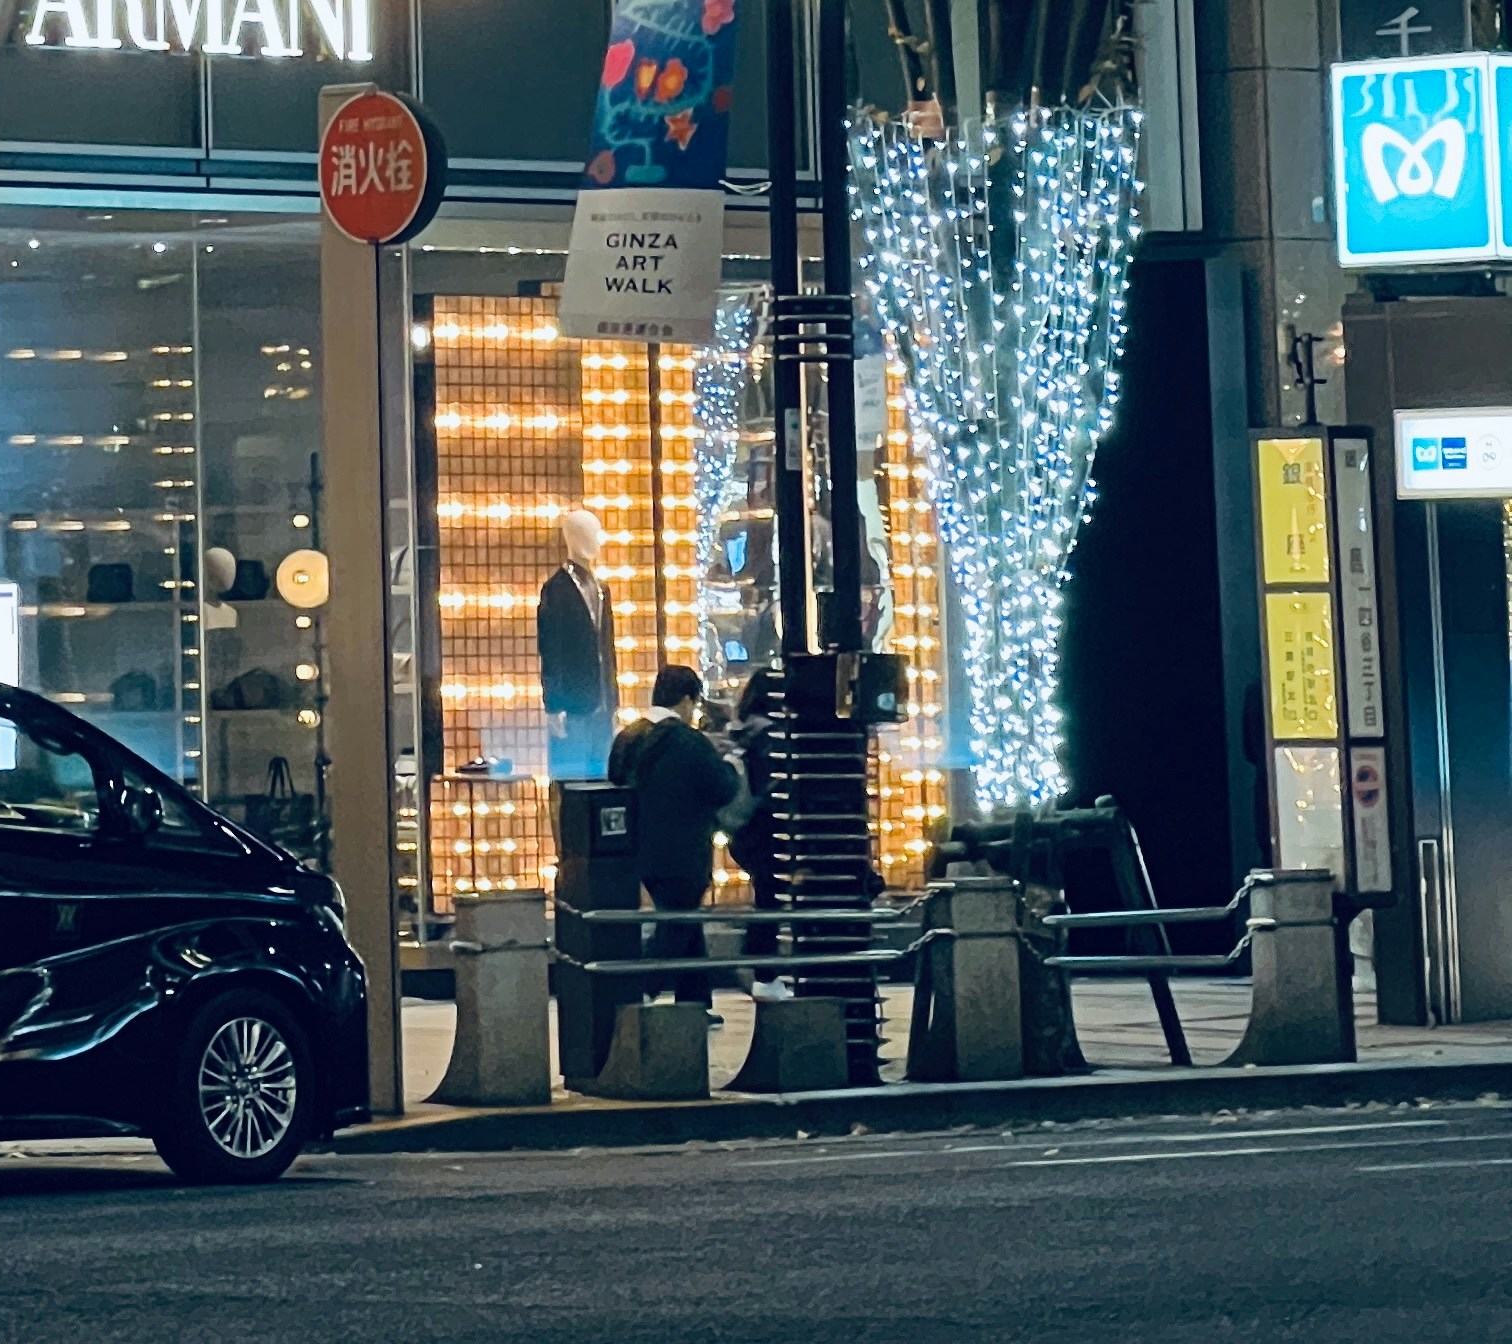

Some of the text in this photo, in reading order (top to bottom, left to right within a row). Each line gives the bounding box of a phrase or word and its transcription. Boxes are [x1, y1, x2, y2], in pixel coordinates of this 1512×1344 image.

[331, 140, 415, 197] 消火栓
[606, 233, 678, 249] GINZA
[615, 255, 664, 271] ART
[605, 277, 673, 294] WALK
